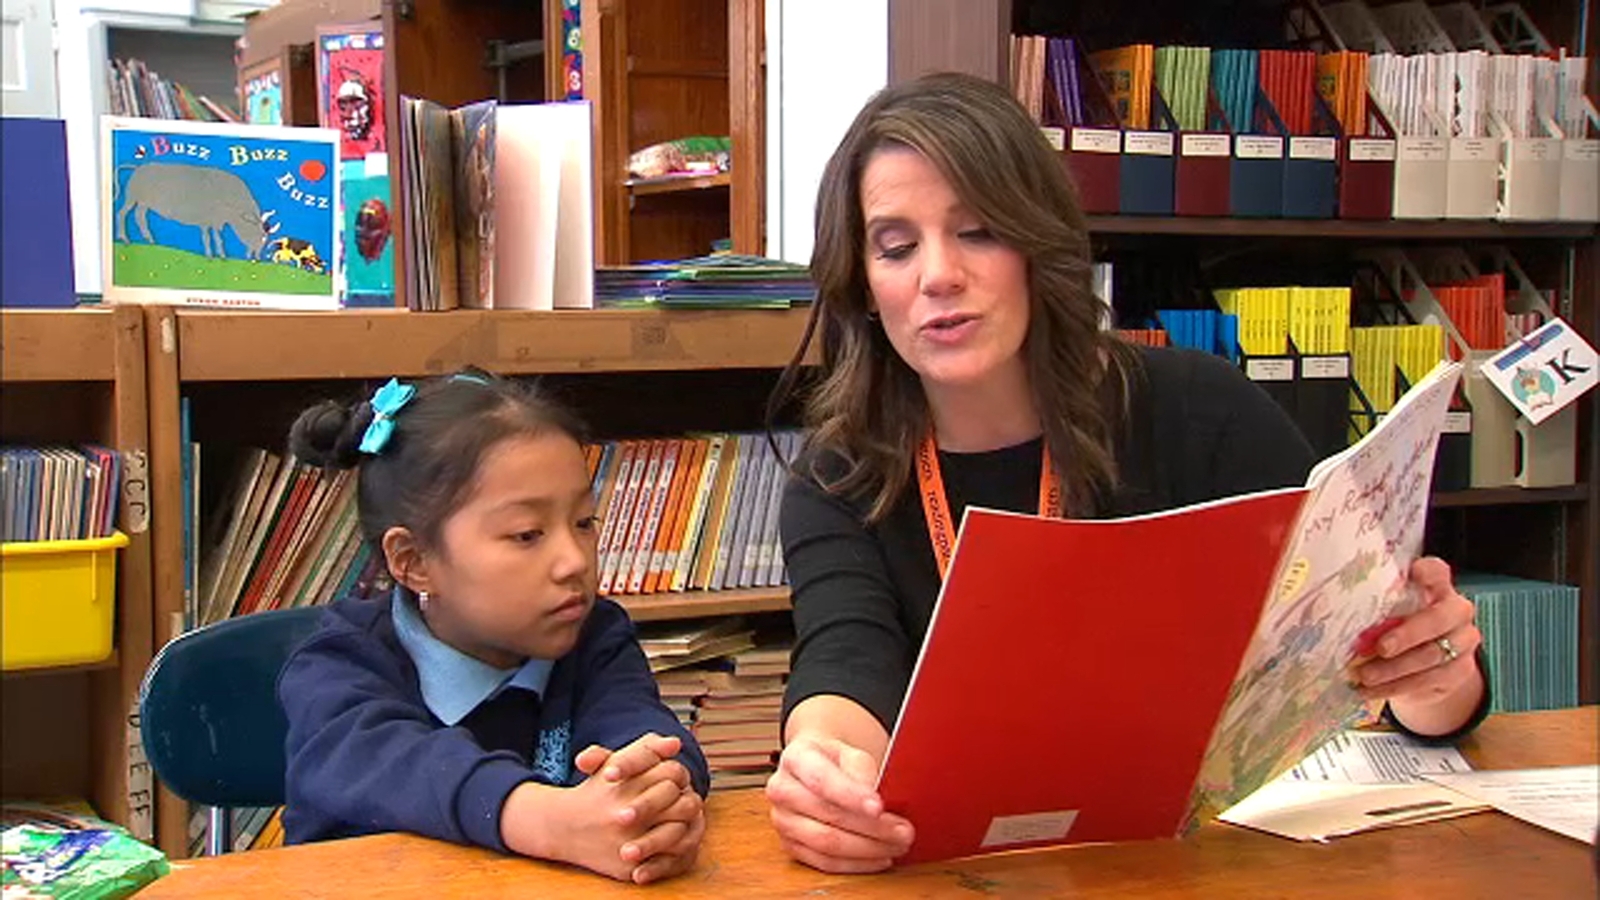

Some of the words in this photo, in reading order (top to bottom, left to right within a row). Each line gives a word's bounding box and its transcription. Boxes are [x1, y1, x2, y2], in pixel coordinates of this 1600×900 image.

[151, 135, 211, 160] Buzz
[229, 145, 290, 166] Buzz
[277, 172, 330, 209] Buzz
[1545, 347, 1591, 386] K
